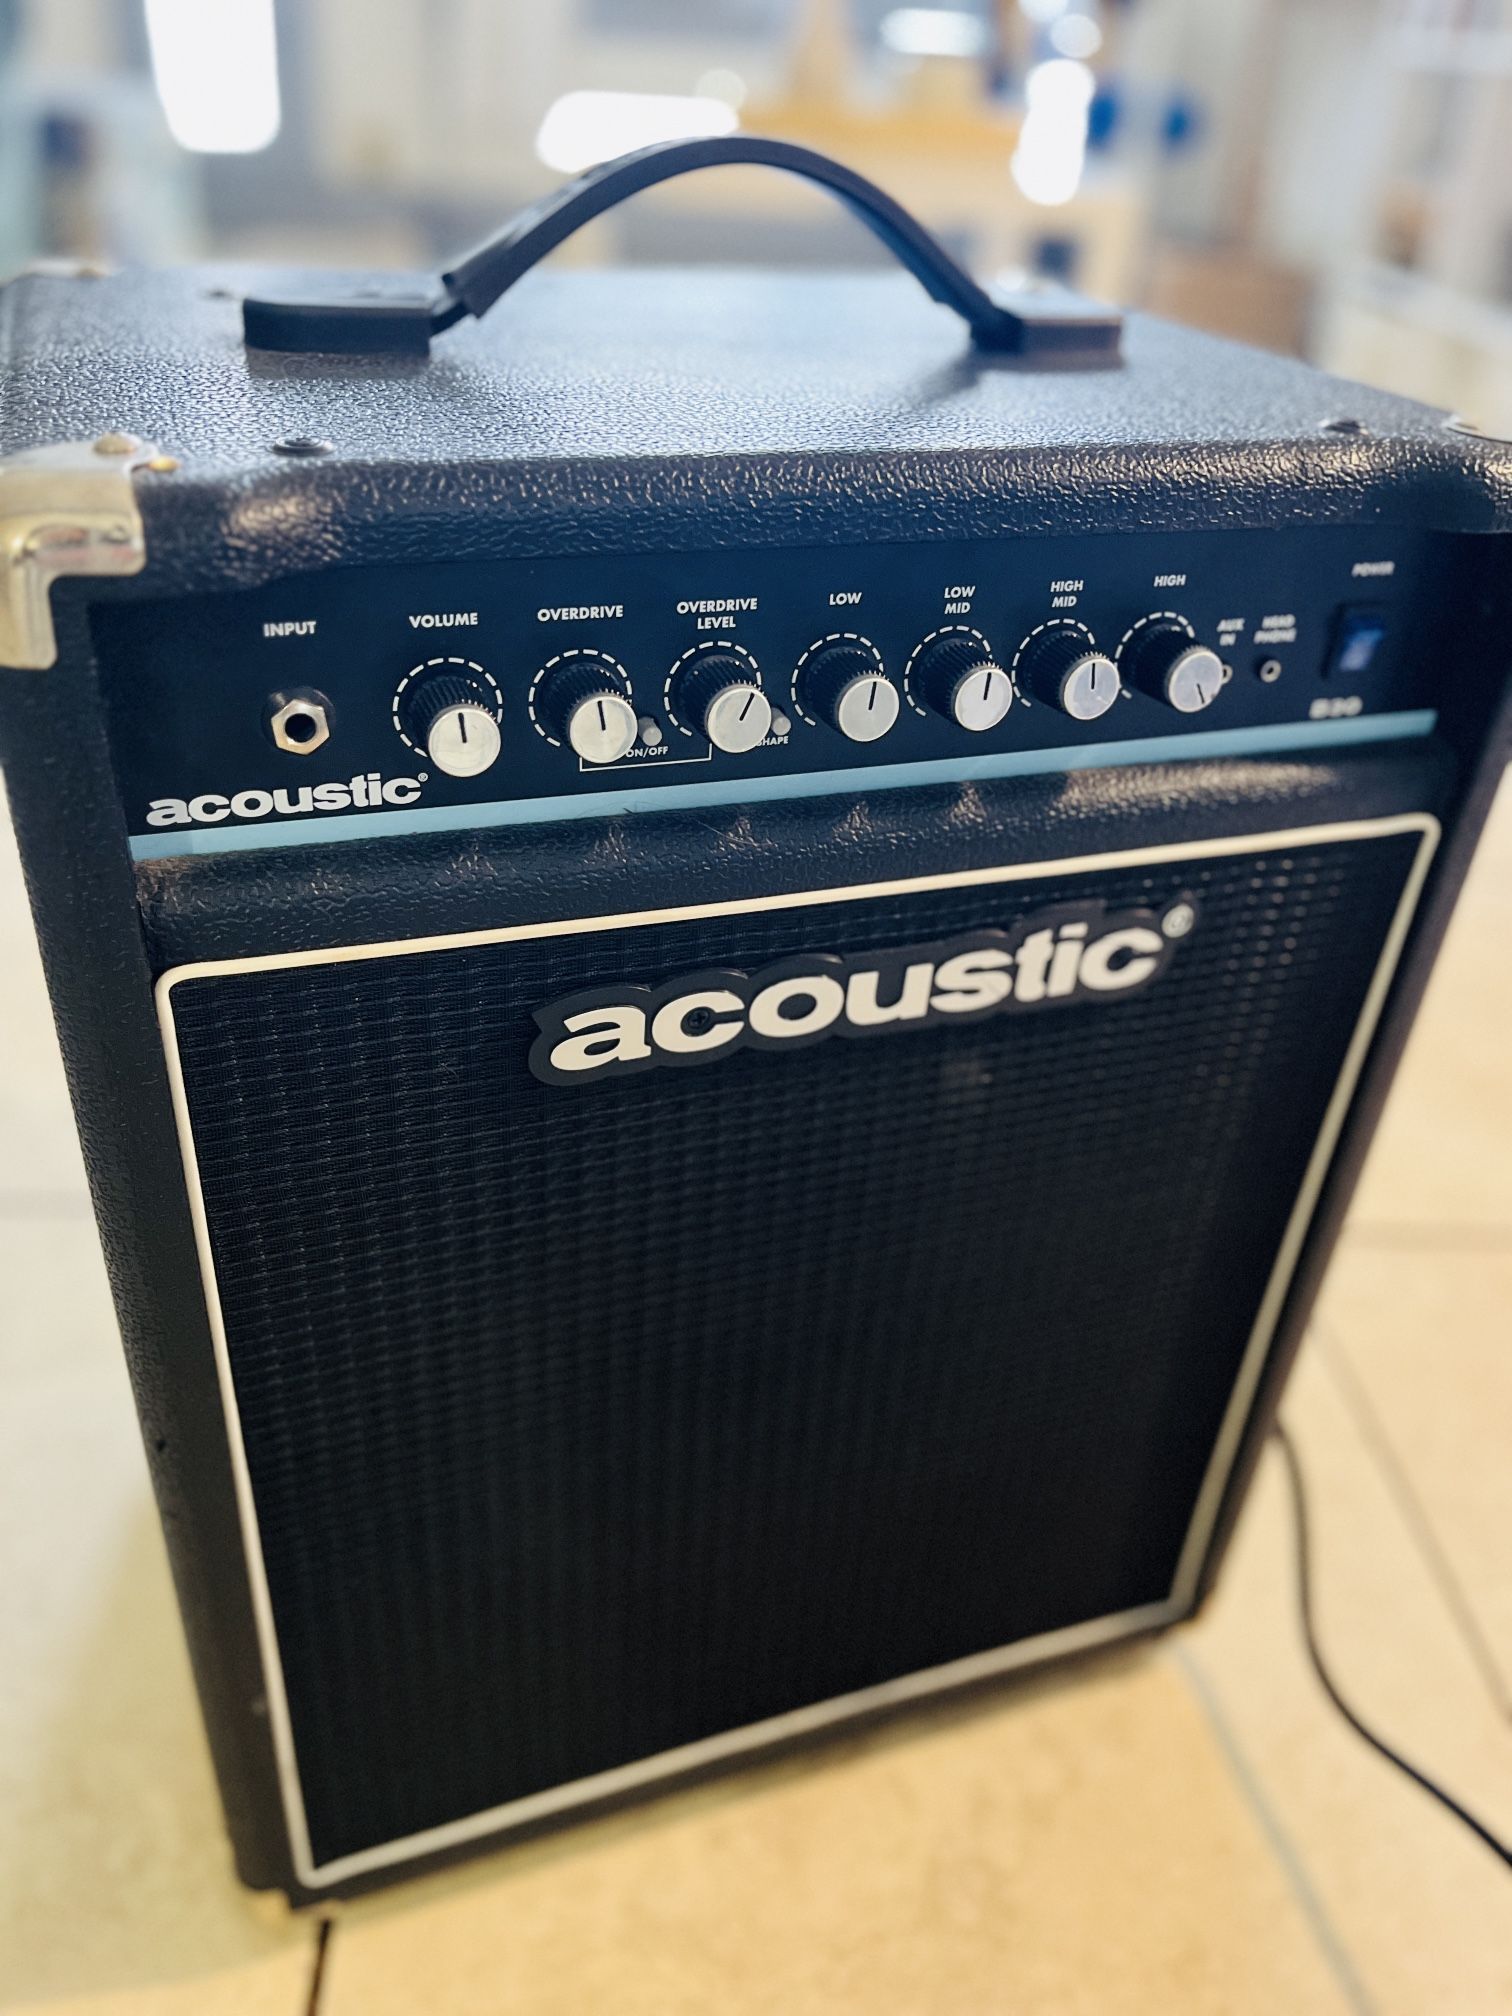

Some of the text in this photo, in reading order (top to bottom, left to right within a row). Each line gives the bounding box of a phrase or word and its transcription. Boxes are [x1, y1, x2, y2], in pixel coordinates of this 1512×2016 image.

[1050, 579, 1084, 593] HIGH
[1153, 574, 1187, 588] HIGH
[829, 591, 862, 606] LOW
[944, 585, 976, 599] LOW
[676, 597, 758, 615] OVERDRIVE
[944, 602, 971, 615] MID
[1051, 595, 1077, 608] MID
[537, 604, 624, 622] OVERDRIVE
[408, 612, 479, 629] VOLUME
[697, 615, 737, 630] LEVEL
[264, 620, 317, 637] INPUT
[1219, 633, 1236, 646] IN
[625, 745, 669, 758] ON/OFF
